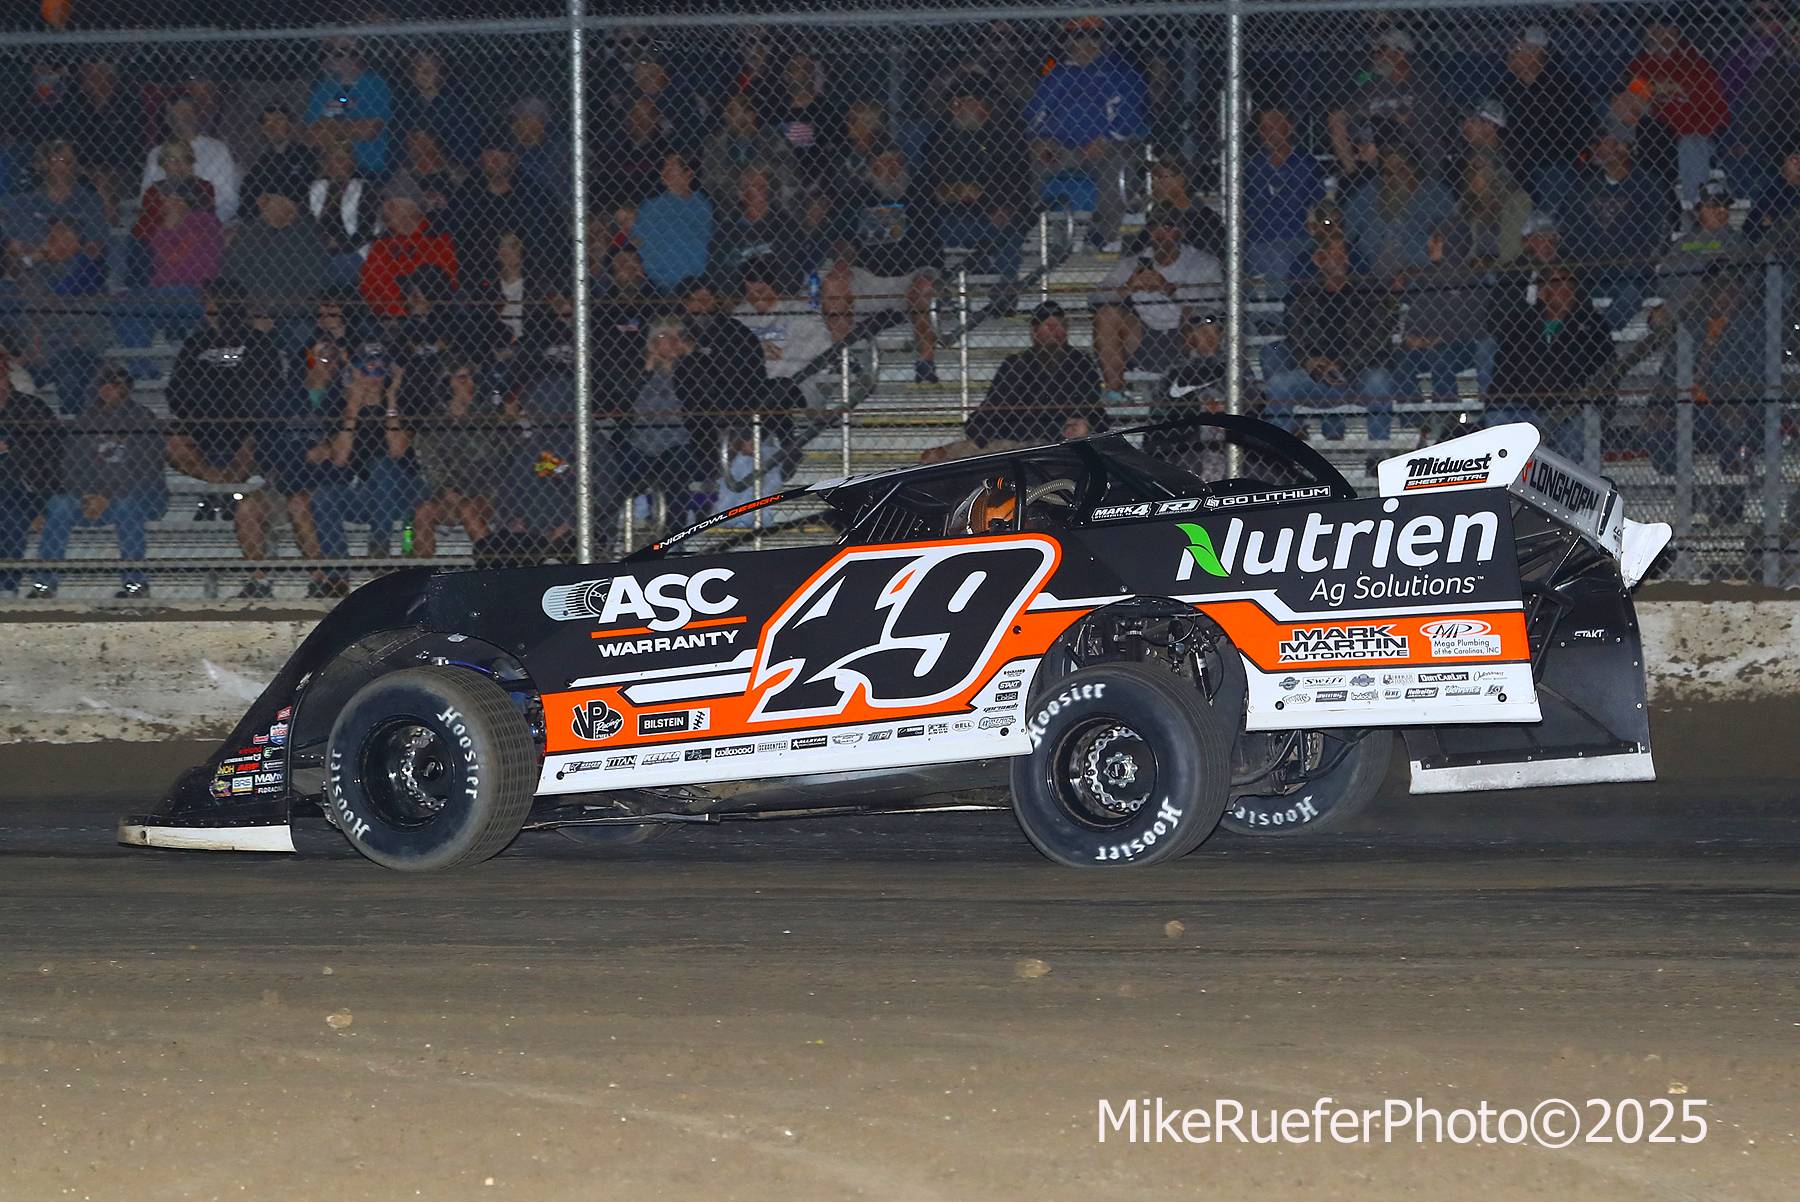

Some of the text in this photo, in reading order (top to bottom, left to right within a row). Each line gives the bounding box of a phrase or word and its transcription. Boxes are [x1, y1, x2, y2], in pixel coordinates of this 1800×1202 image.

[1406, 453, 1492, 477] Midwest
[1407, 473, 1487, 486] SHEET METAL
[1529, 458, 1600, 519] LONGHORN
[1222, 487, 1330, 506] GO LITHIUM
[1094, 506, 1133, 516] MARK
[1132, 503, 1149, 517] 4
[1175, 497, 1499, 581] Nutrien
[598, 567, 740, 632] ASC
[1309, 578, 1347, 607] Ag
[756, 544, 1050, 716] 49
[1293, 625, 1391, 642] MARK
[1432, 623, 1473, 639] MP
[597, 629, 740, 658] WARRANTY
[1280, 636, 1407, 654] MARTIN
[1434, 638, 1490, 649] Mega Plumbing
[1434, 648, 1442, 656] of
[1443, 647, 1453, 655] the
[1485, 646, 1499, 654] INC
[1281, 649, 1408, 662] AUTOMOTIVE
[1305, 677, 1344, 685] Swift
[573, 700, 609, 739] VP
[643, 716, 685, 730] BILSTEIN
[1028, 682, 1107, 749] Hoosier
[596, 718, 622, 734] Racing
[436, 705, 480, 800] Hoosier
[715, 743, 755, 758] wilwood
[606, 757, 636, 767] TITAN
[330, 748, 372, 841] Hoosier
[1094, 796, 1184, 862] Hoosier
